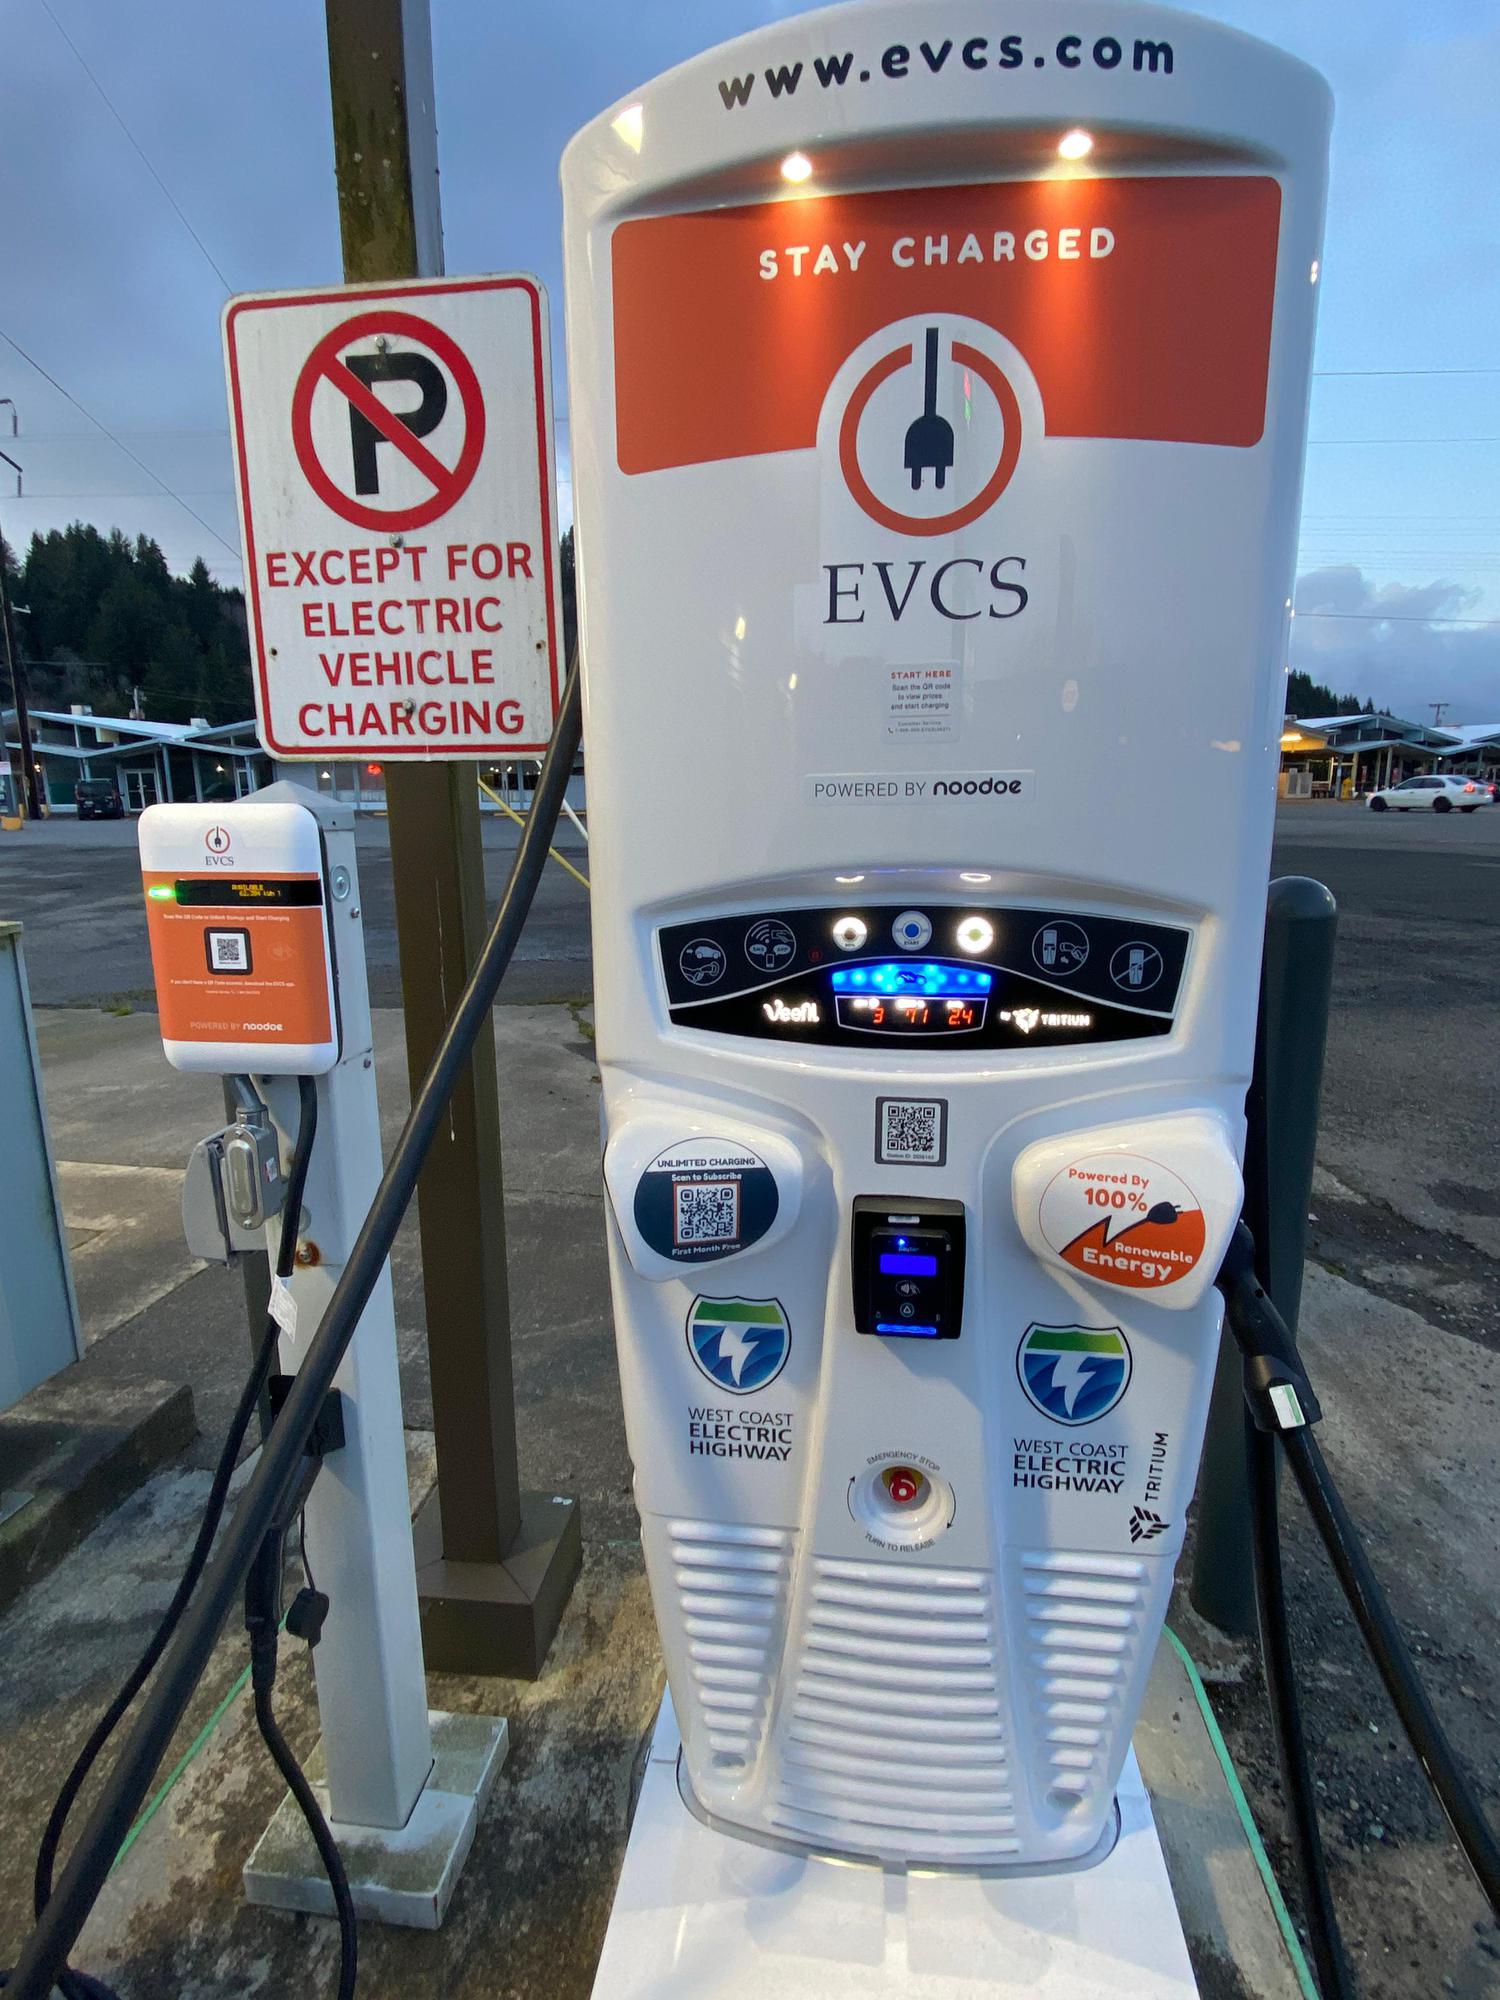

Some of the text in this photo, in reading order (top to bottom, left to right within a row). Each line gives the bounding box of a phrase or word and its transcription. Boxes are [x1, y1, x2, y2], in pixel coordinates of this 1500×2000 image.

[718, 34, 1175, 110] www.evcs.com
[759, 227, 1117, 281] STAY CHARGED
[266, 542, 534, 587] EXCEPT FOR
[822, 556, 1029, 624] EVCS
[302, 596, 504, 637] ELECTRIC
[319, 649, 496, 688] VEHICLE
[890, 670, 952, 679] START HERE
[921, 702, 950, 710] charging
[298, 700, 525, 737] CHARGING
[814, 777, 1022, 797] POWERED BY noodoe
[205, 856, 235, 866] EVCS
[190, 1021, 283, 1031] POWERED BY noodoe
[873, 1008, 885, 1023] 3
[948, 1008, 973, 1025] 2.4
[1041, 1013, 1090, 1026] TRITIUM
[657, 1157, 755, 1168] UNLIMITED CHARGING
[671, 1174, 691, 1182] Scan
[703, 1172, 742, 1181] Subscribe
[1068, 1168, 1150, 1189] Powered By
[1084, 1188, 1148, 1212] 100%
[671, 1248, 692, 1256] First
[693, 1244, 721, 1254] Month
[1115, 1242, 1194, 1264] Renewable
[1082, 1247, 1172, 1282] Energy
[687, 1406, 794, 1427] WEST COAST
[689, 1422, 792, 1445] ELECTRIC
[690, 1440, 793, 1462] HIGHWAY
[1013, 1437, 1129, 1459] WEST COAST
[866, 1450, 941, 1471] EMERGENCY STOP
[1014, 1454, 1126, 1477] ELECTRIC
[1144, 1432, 1169, 1502] TRITIUM
[1013, 1472, 1125, 1494] HIGHWAY
[865, 1531, 936, 1553] TURN TO RELEASE
